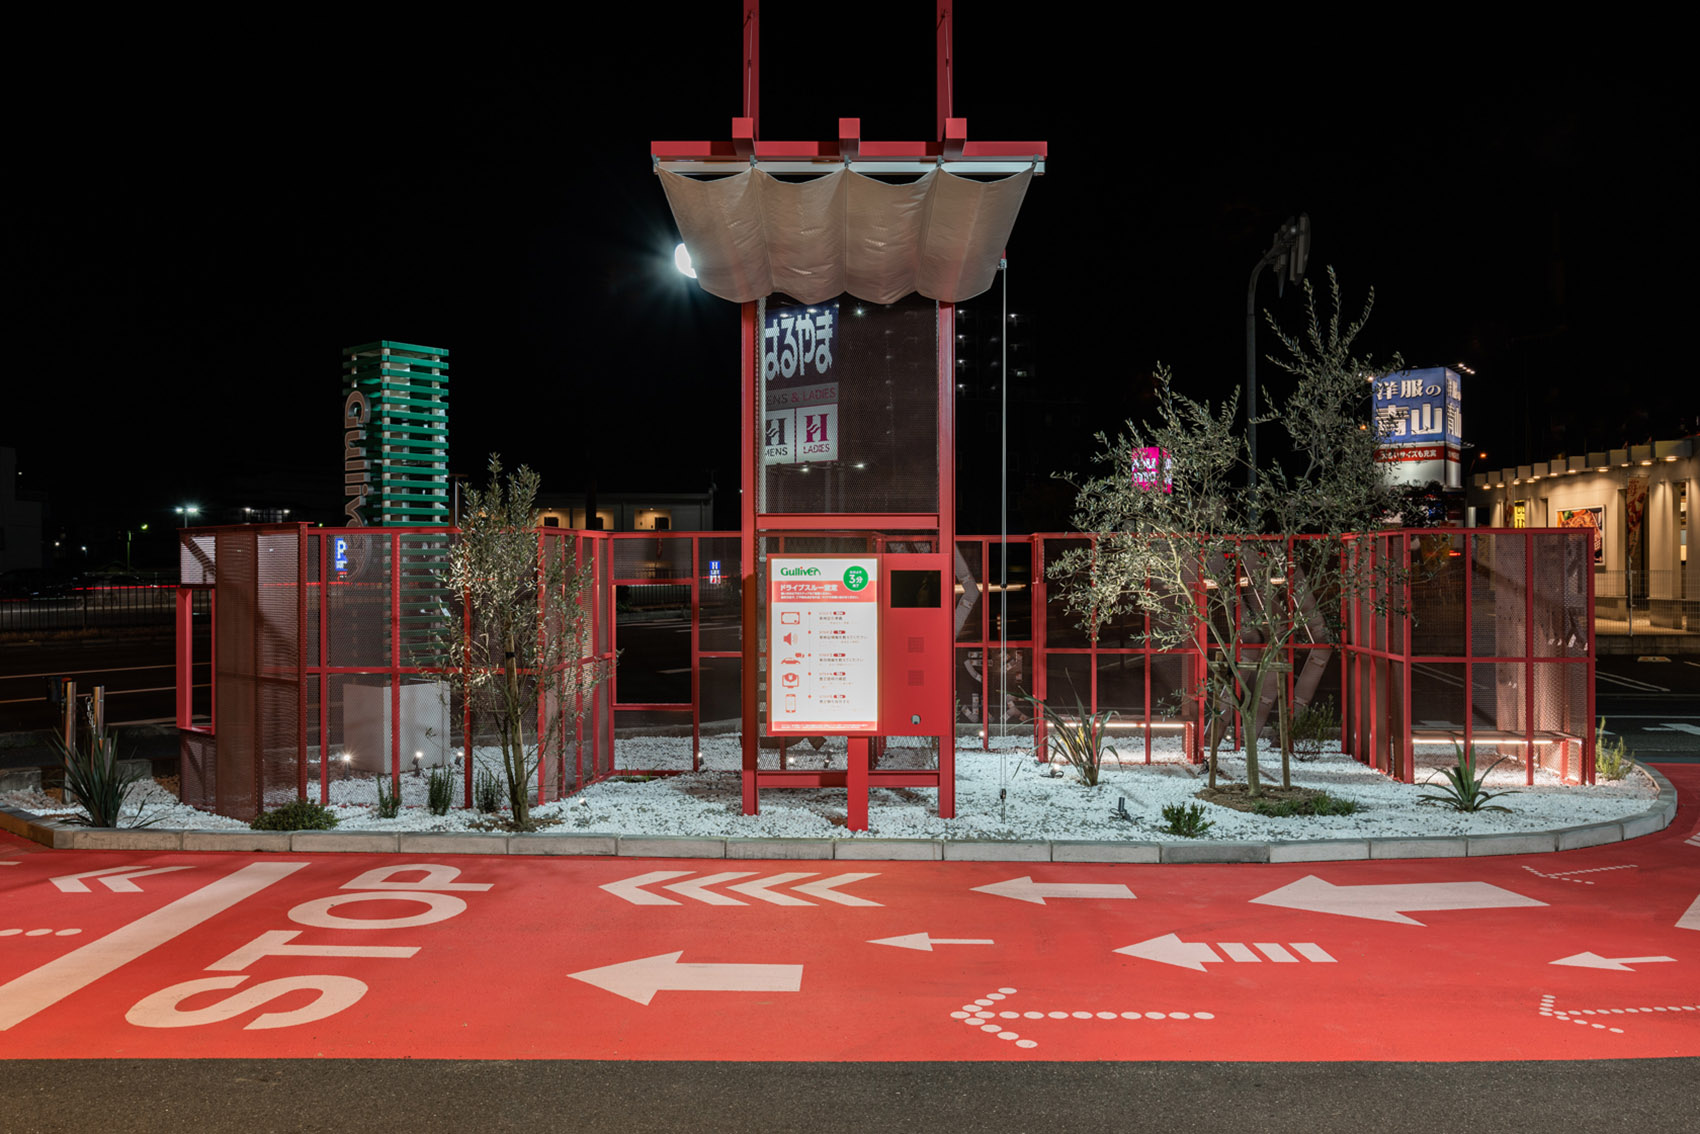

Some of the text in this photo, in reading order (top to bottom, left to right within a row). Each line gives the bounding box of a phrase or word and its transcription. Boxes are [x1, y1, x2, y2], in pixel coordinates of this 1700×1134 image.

[792, 392, 800, 403] &
[802, 386, 836, 402] LADIES
[1376, 379, 1442, 400] 洋服の
[804, 413, 830, 444] H
[1375, 403, 1442, 436] 青山
[803, 443, 830, 454] LADIES
[780, 566, 821, 576] Gulliver
[849, 574, 864, 584] 3分
[125, 863, 494, 1030] STOP
